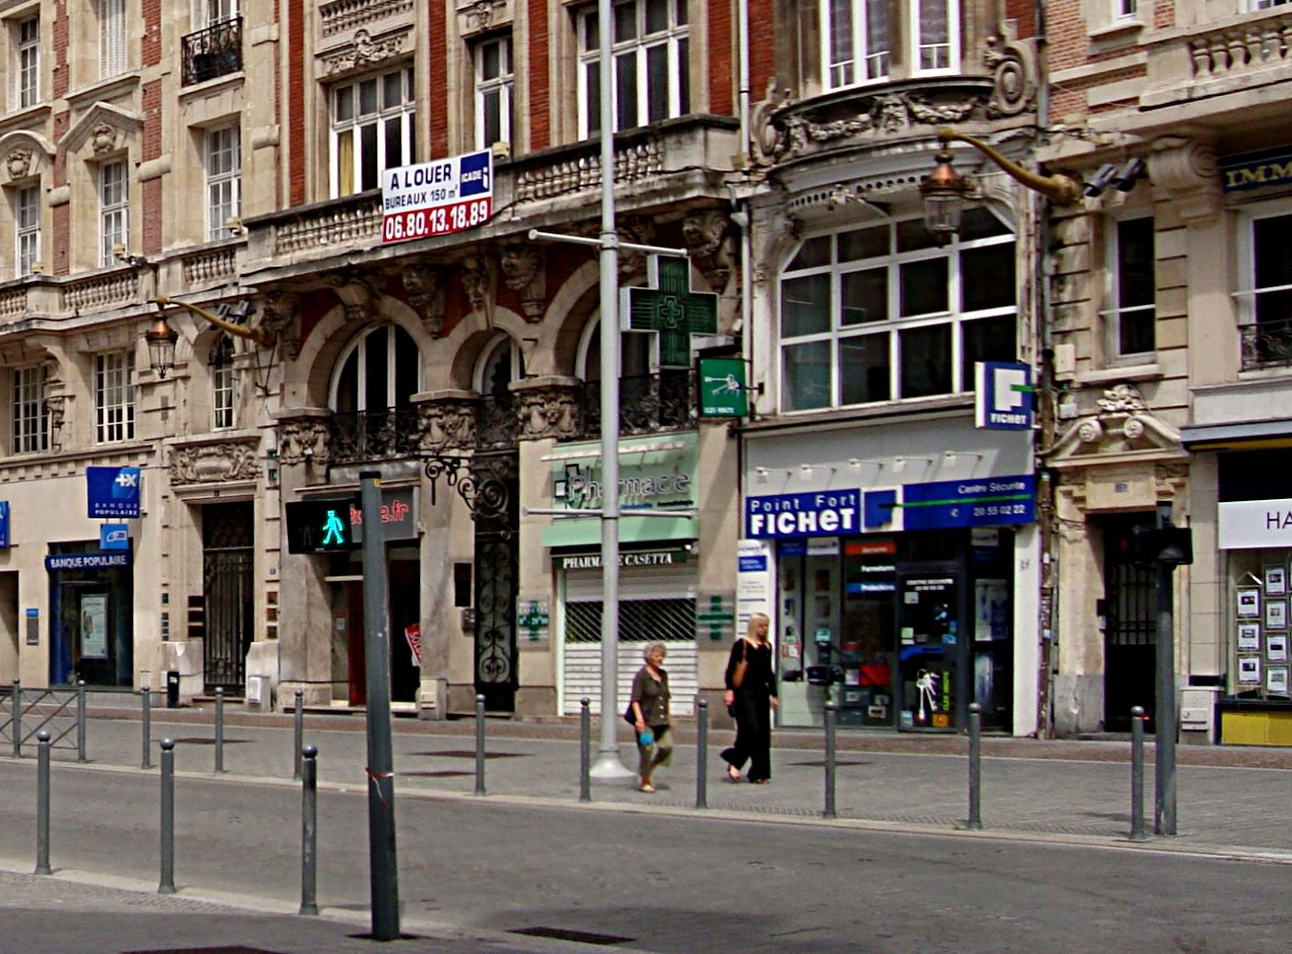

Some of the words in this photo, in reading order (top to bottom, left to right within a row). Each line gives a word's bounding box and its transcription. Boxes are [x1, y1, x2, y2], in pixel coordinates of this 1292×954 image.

[390, 173, 400, 191] A
[404, 163, 452, 188] LOUER
[385, 192, 427, 210] BUREAUX
[430, 189, 446, 202] 150
[385, 200, 488, 240] 06.80.13.18.89
[990, 412, 1027, 425] FICHET
[958, 484, 987, 494] Centre
[750, 497, 800, 513] Point
[815, 493, 856, 508] Fort
[973, 506, 986, 516] 20
[1012, 503, 1026, 514] 22
[750, 507, 856, 536] FICHET
[50, 557, 83, 569] BANQUE
[83, 554, 127, 567] POPULAIRE
[625, 552, 673, 566] CASETTA
